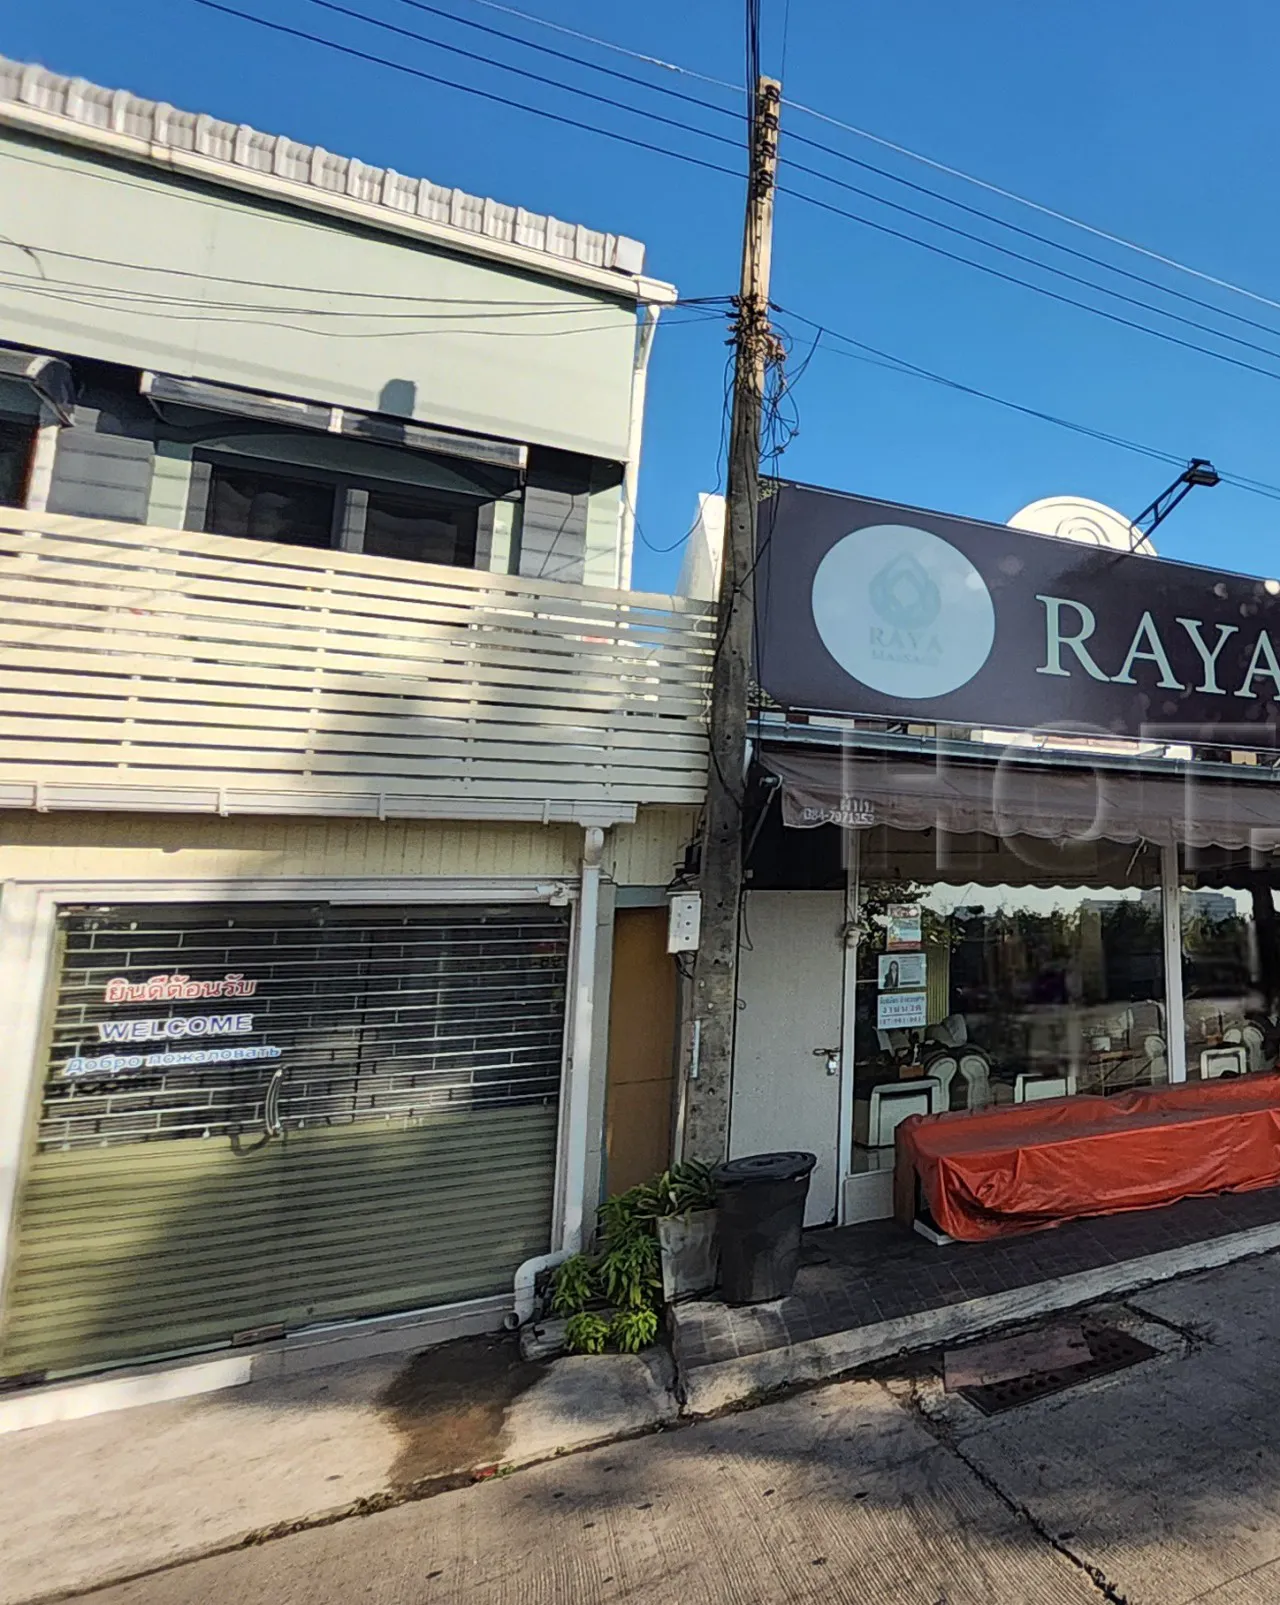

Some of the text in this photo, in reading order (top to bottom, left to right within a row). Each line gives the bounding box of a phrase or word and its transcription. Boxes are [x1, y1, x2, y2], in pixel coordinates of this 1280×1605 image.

[869, 625, 944, 655] RAYA
[104, 973, 257, 1002] ยินดีต้อนรับ
[98, 1013, 254, 1043] WELCOME
[63, 1046, 282, 1077] Добро пожаловать
